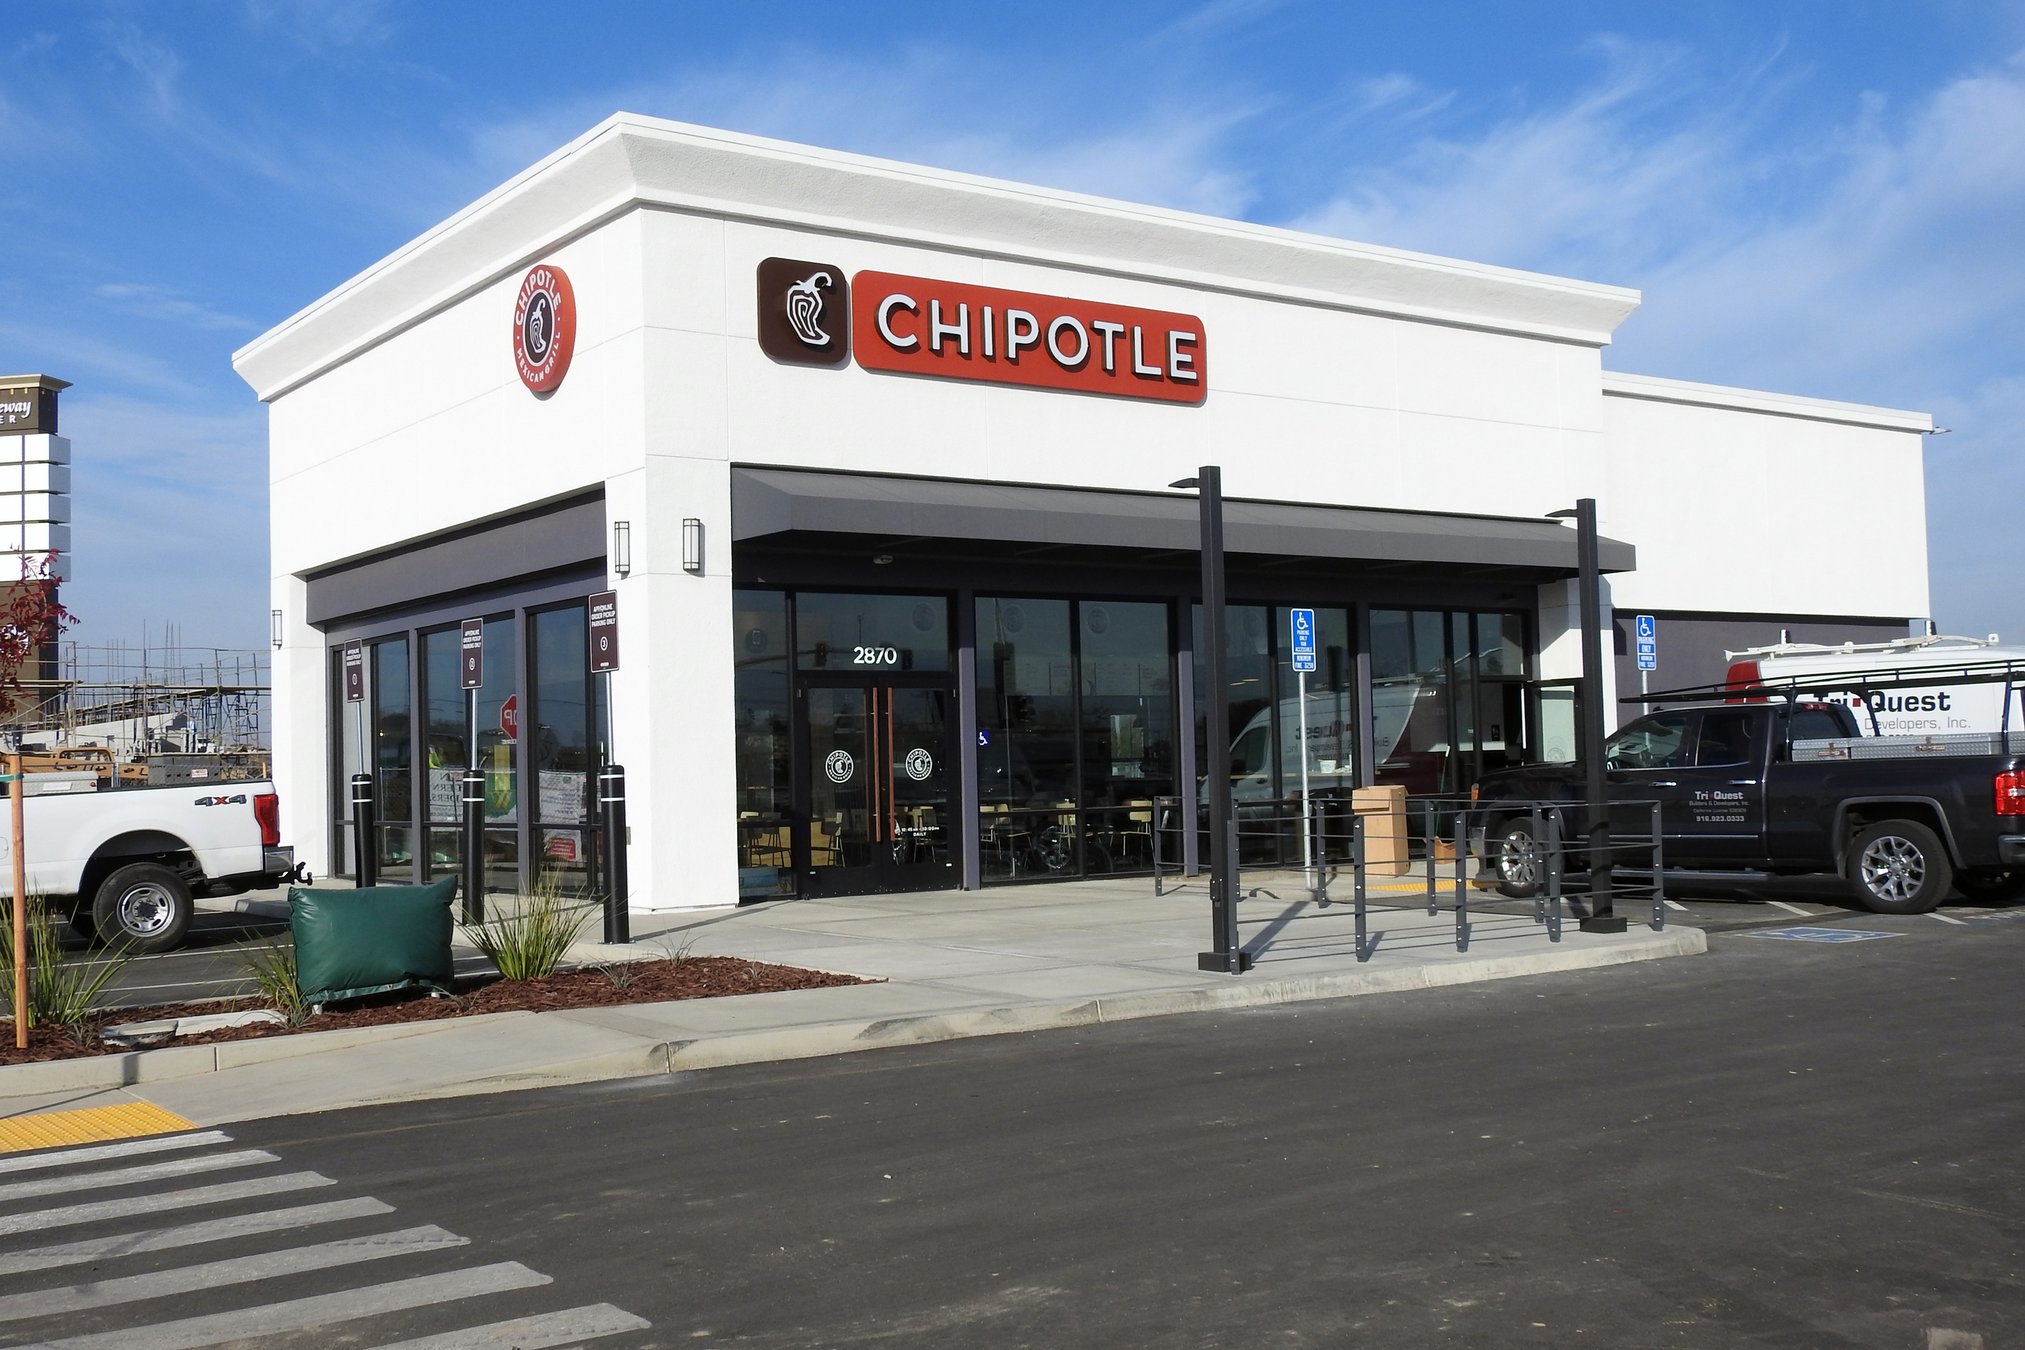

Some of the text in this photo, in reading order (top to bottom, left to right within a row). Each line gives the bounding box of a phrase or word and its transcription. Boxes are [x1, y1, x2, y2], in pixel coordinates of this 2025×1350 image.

[516, 269, 561, 325] CHIPOTLE
[877, 293, 1197, 380] CHIPOTLE
[517, 332, 560, 383] MEXICAN GRILL
[592, 619, 606, 627] PARKING
[853, 646, 898, 665] 2870
[1868, 691, 1951, 712] Quest
[1864, 716, 1971, 732] Developers, Inc.
[1695, 791, 1744, 800] Tri Quest
